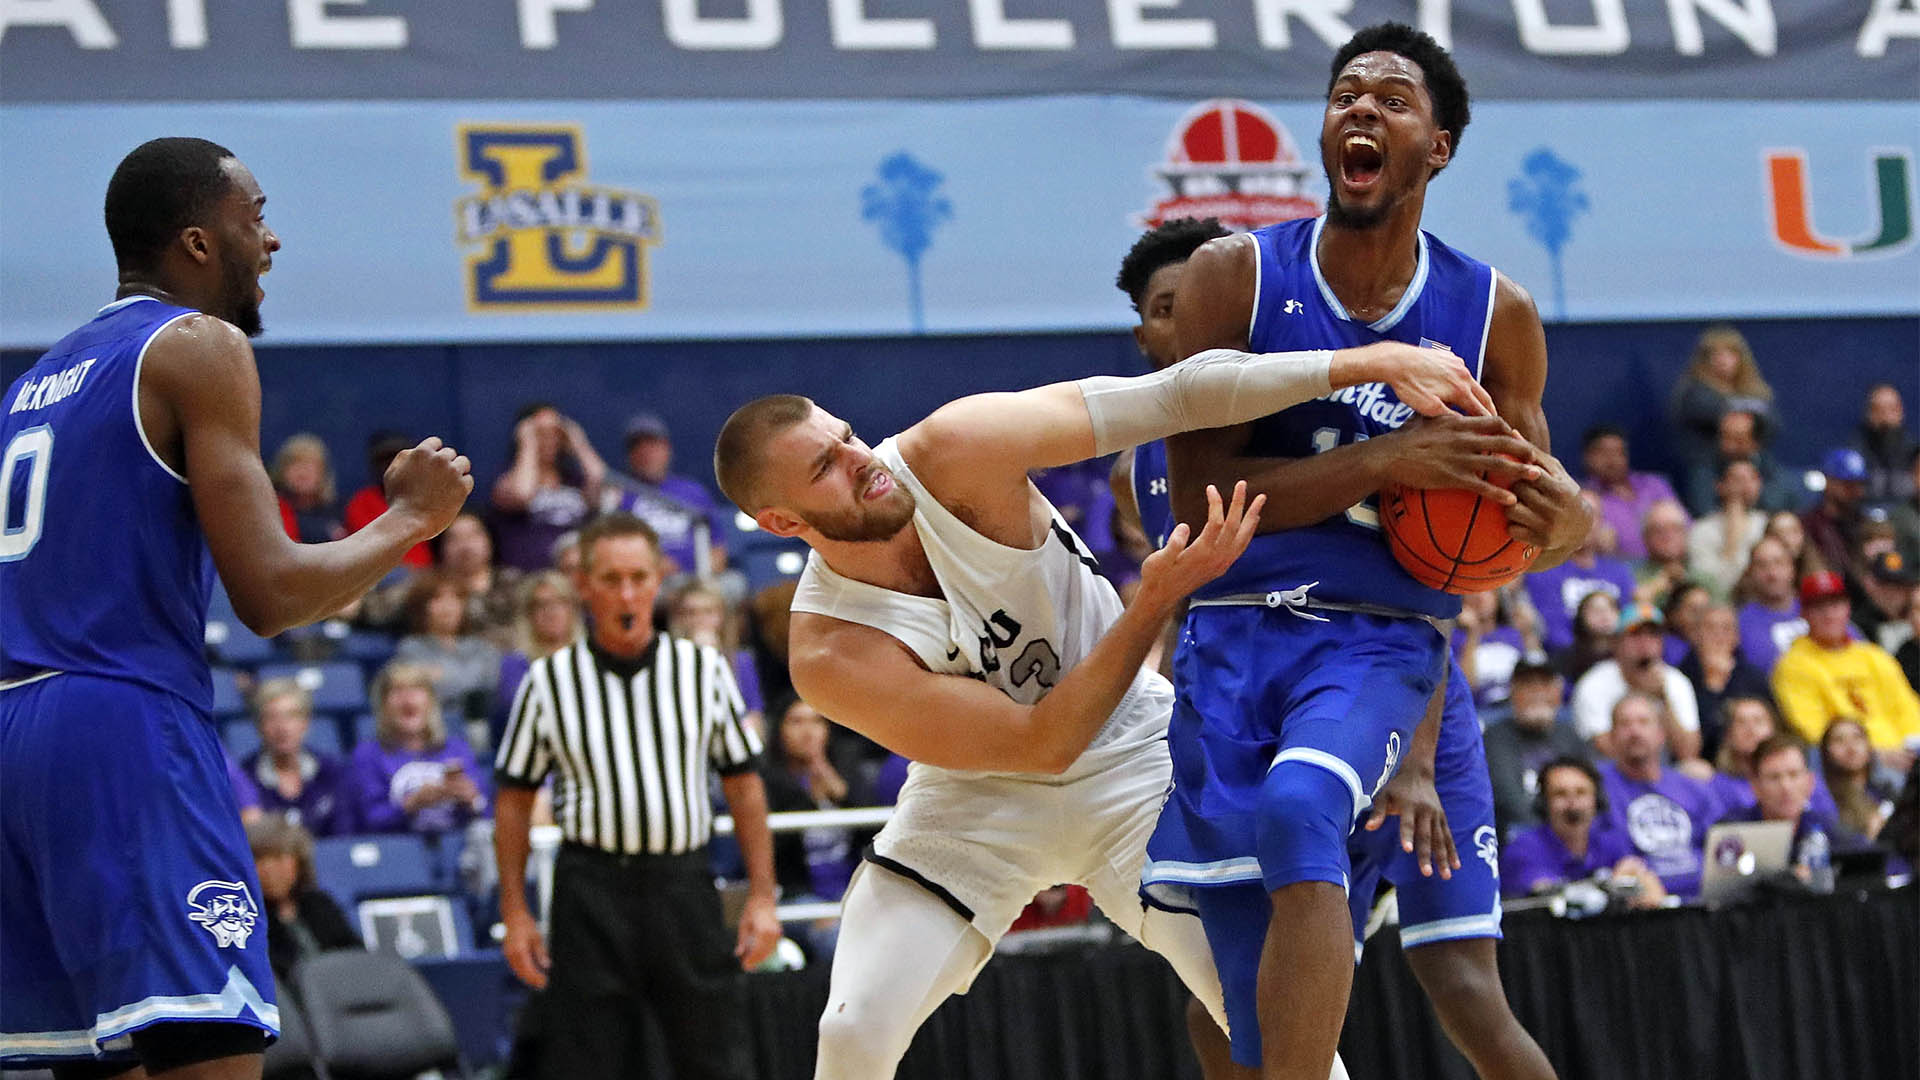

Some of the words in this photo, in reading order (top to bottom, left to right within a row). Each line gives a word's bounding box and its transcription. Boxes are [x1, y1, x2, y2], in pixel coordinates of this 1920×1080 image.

[1764, 147, 1915, 260] U
[0, 422, 55, 563] 0
[967, 608, 1022, 683] CU
